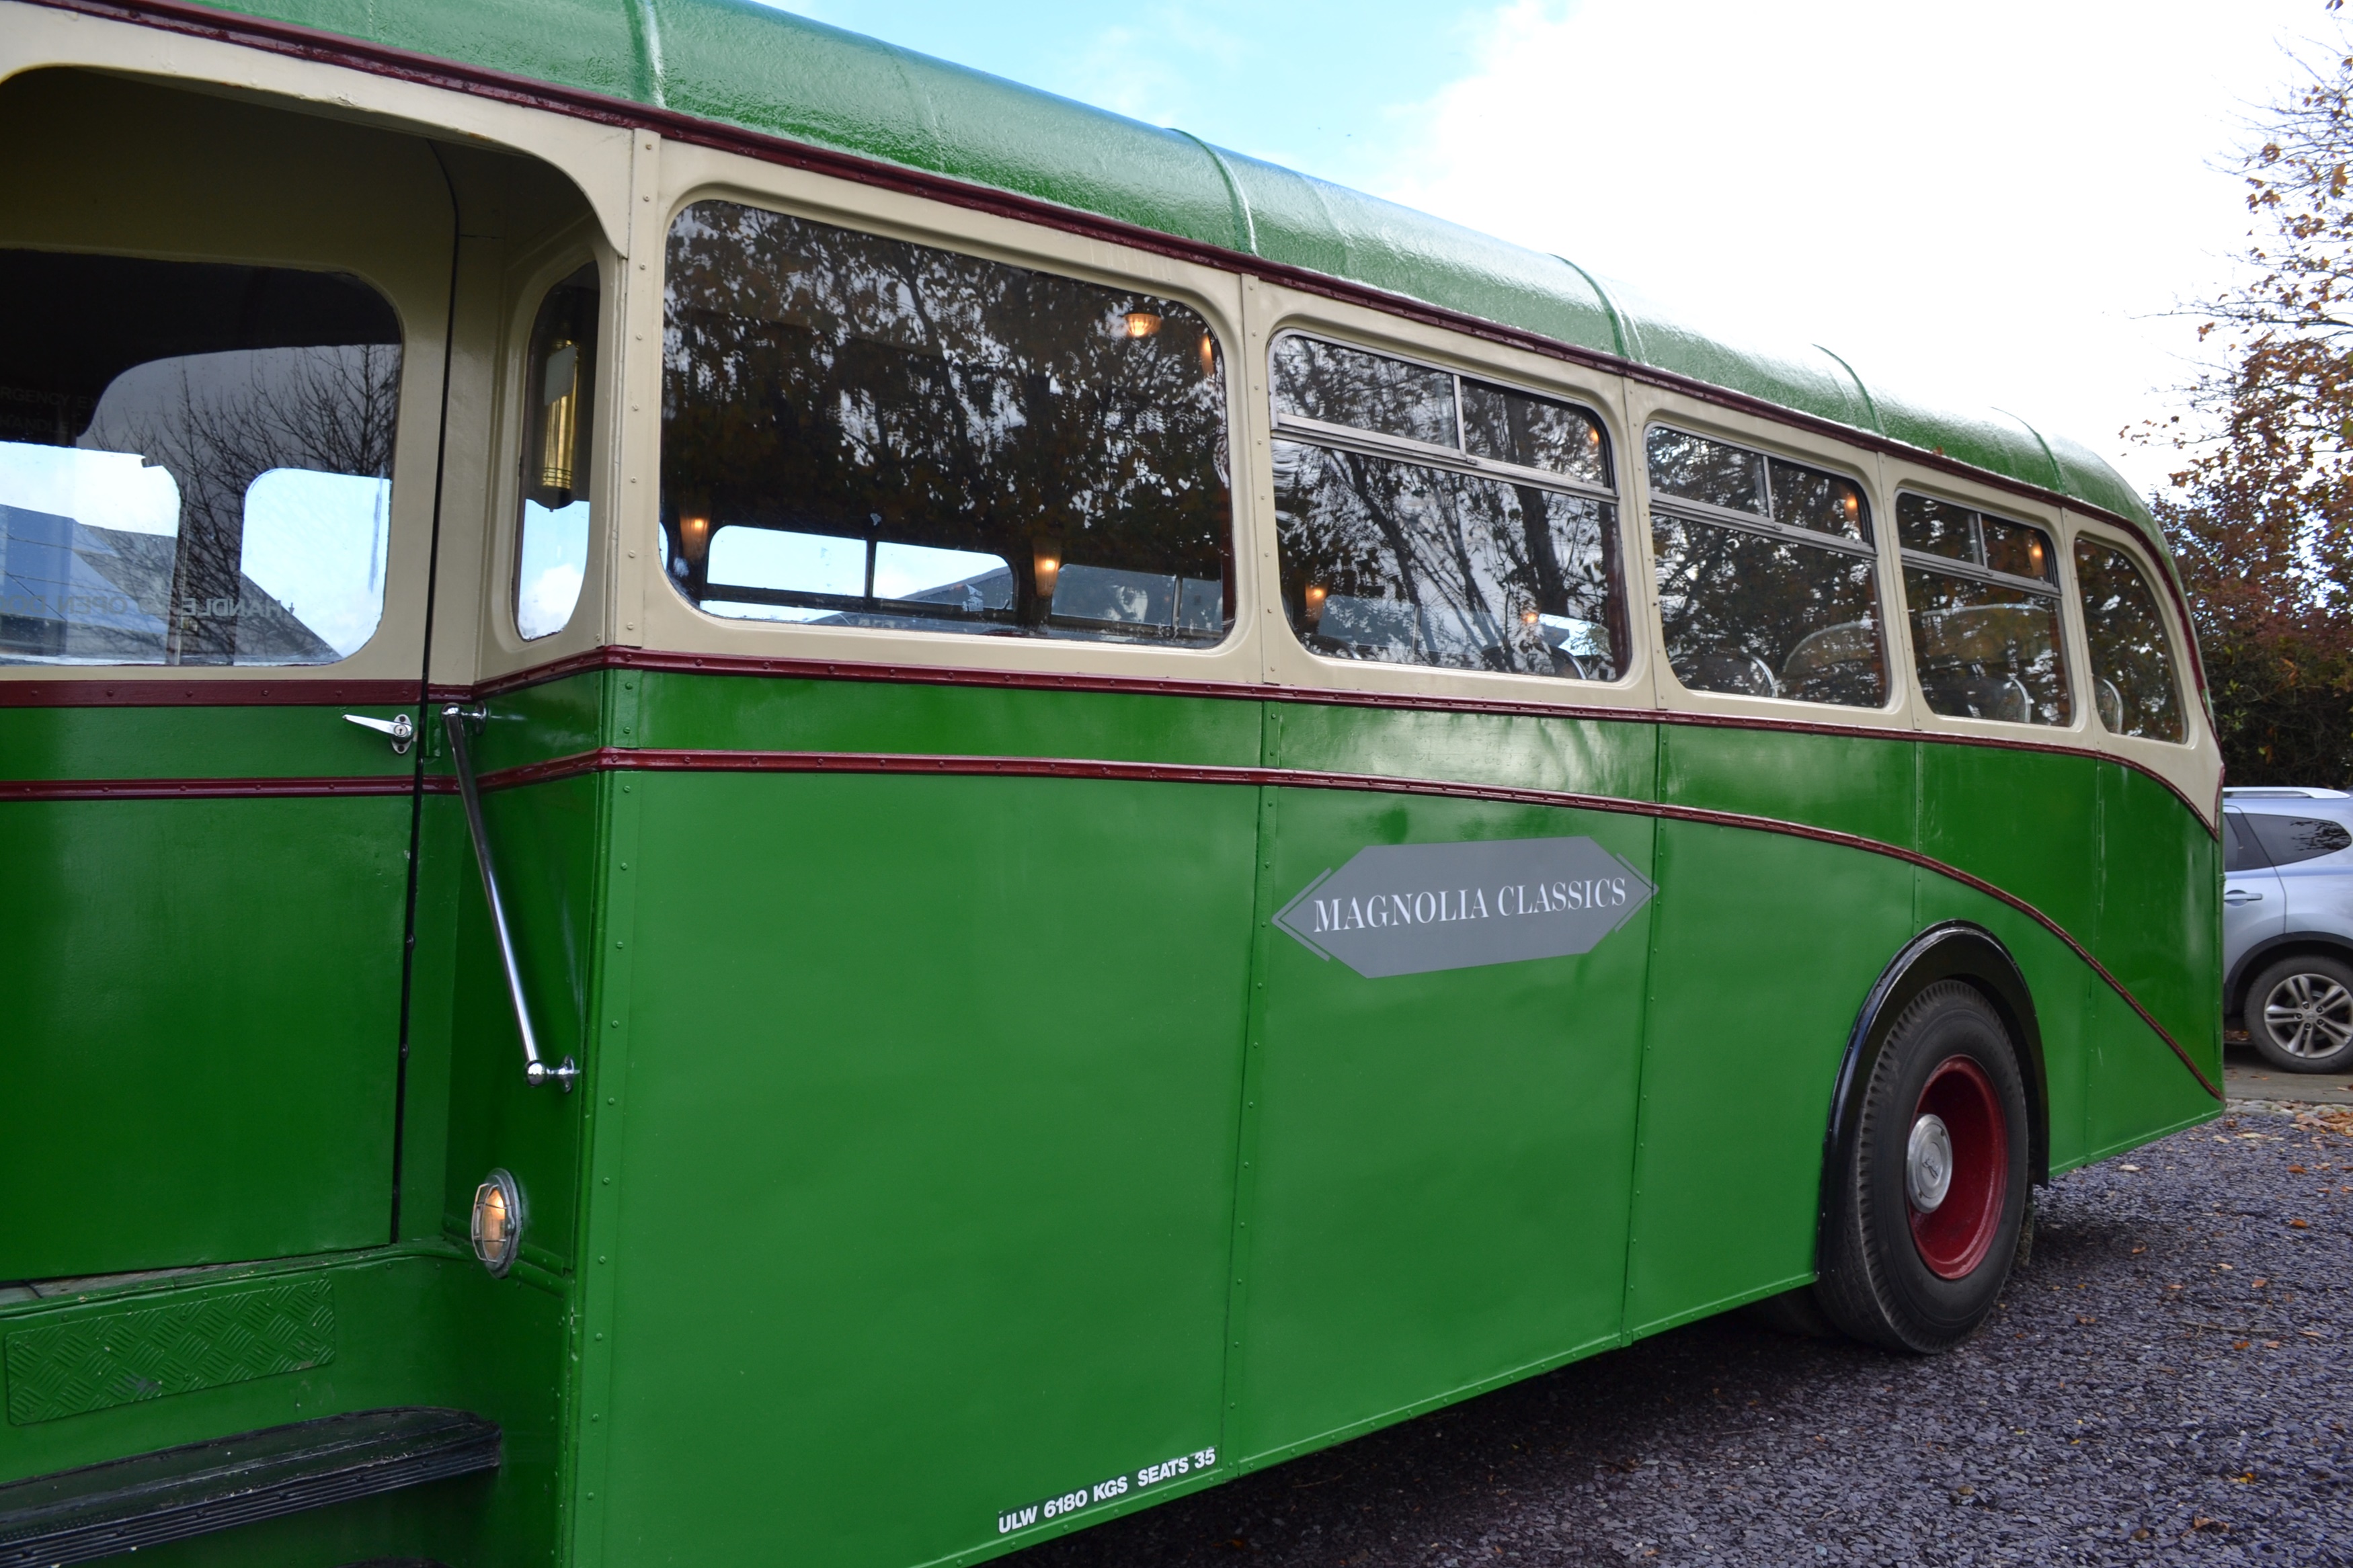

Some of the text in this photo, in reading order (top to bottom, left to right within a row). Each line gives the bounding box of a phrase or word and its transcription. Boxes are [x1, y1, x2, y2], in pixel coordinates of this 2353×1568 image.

[1314, 878, 1626, 932] MAGNOLIA CLASSICS
[998, 1448, 1215, 1534] ULW 6180 KGS SEATS 35
